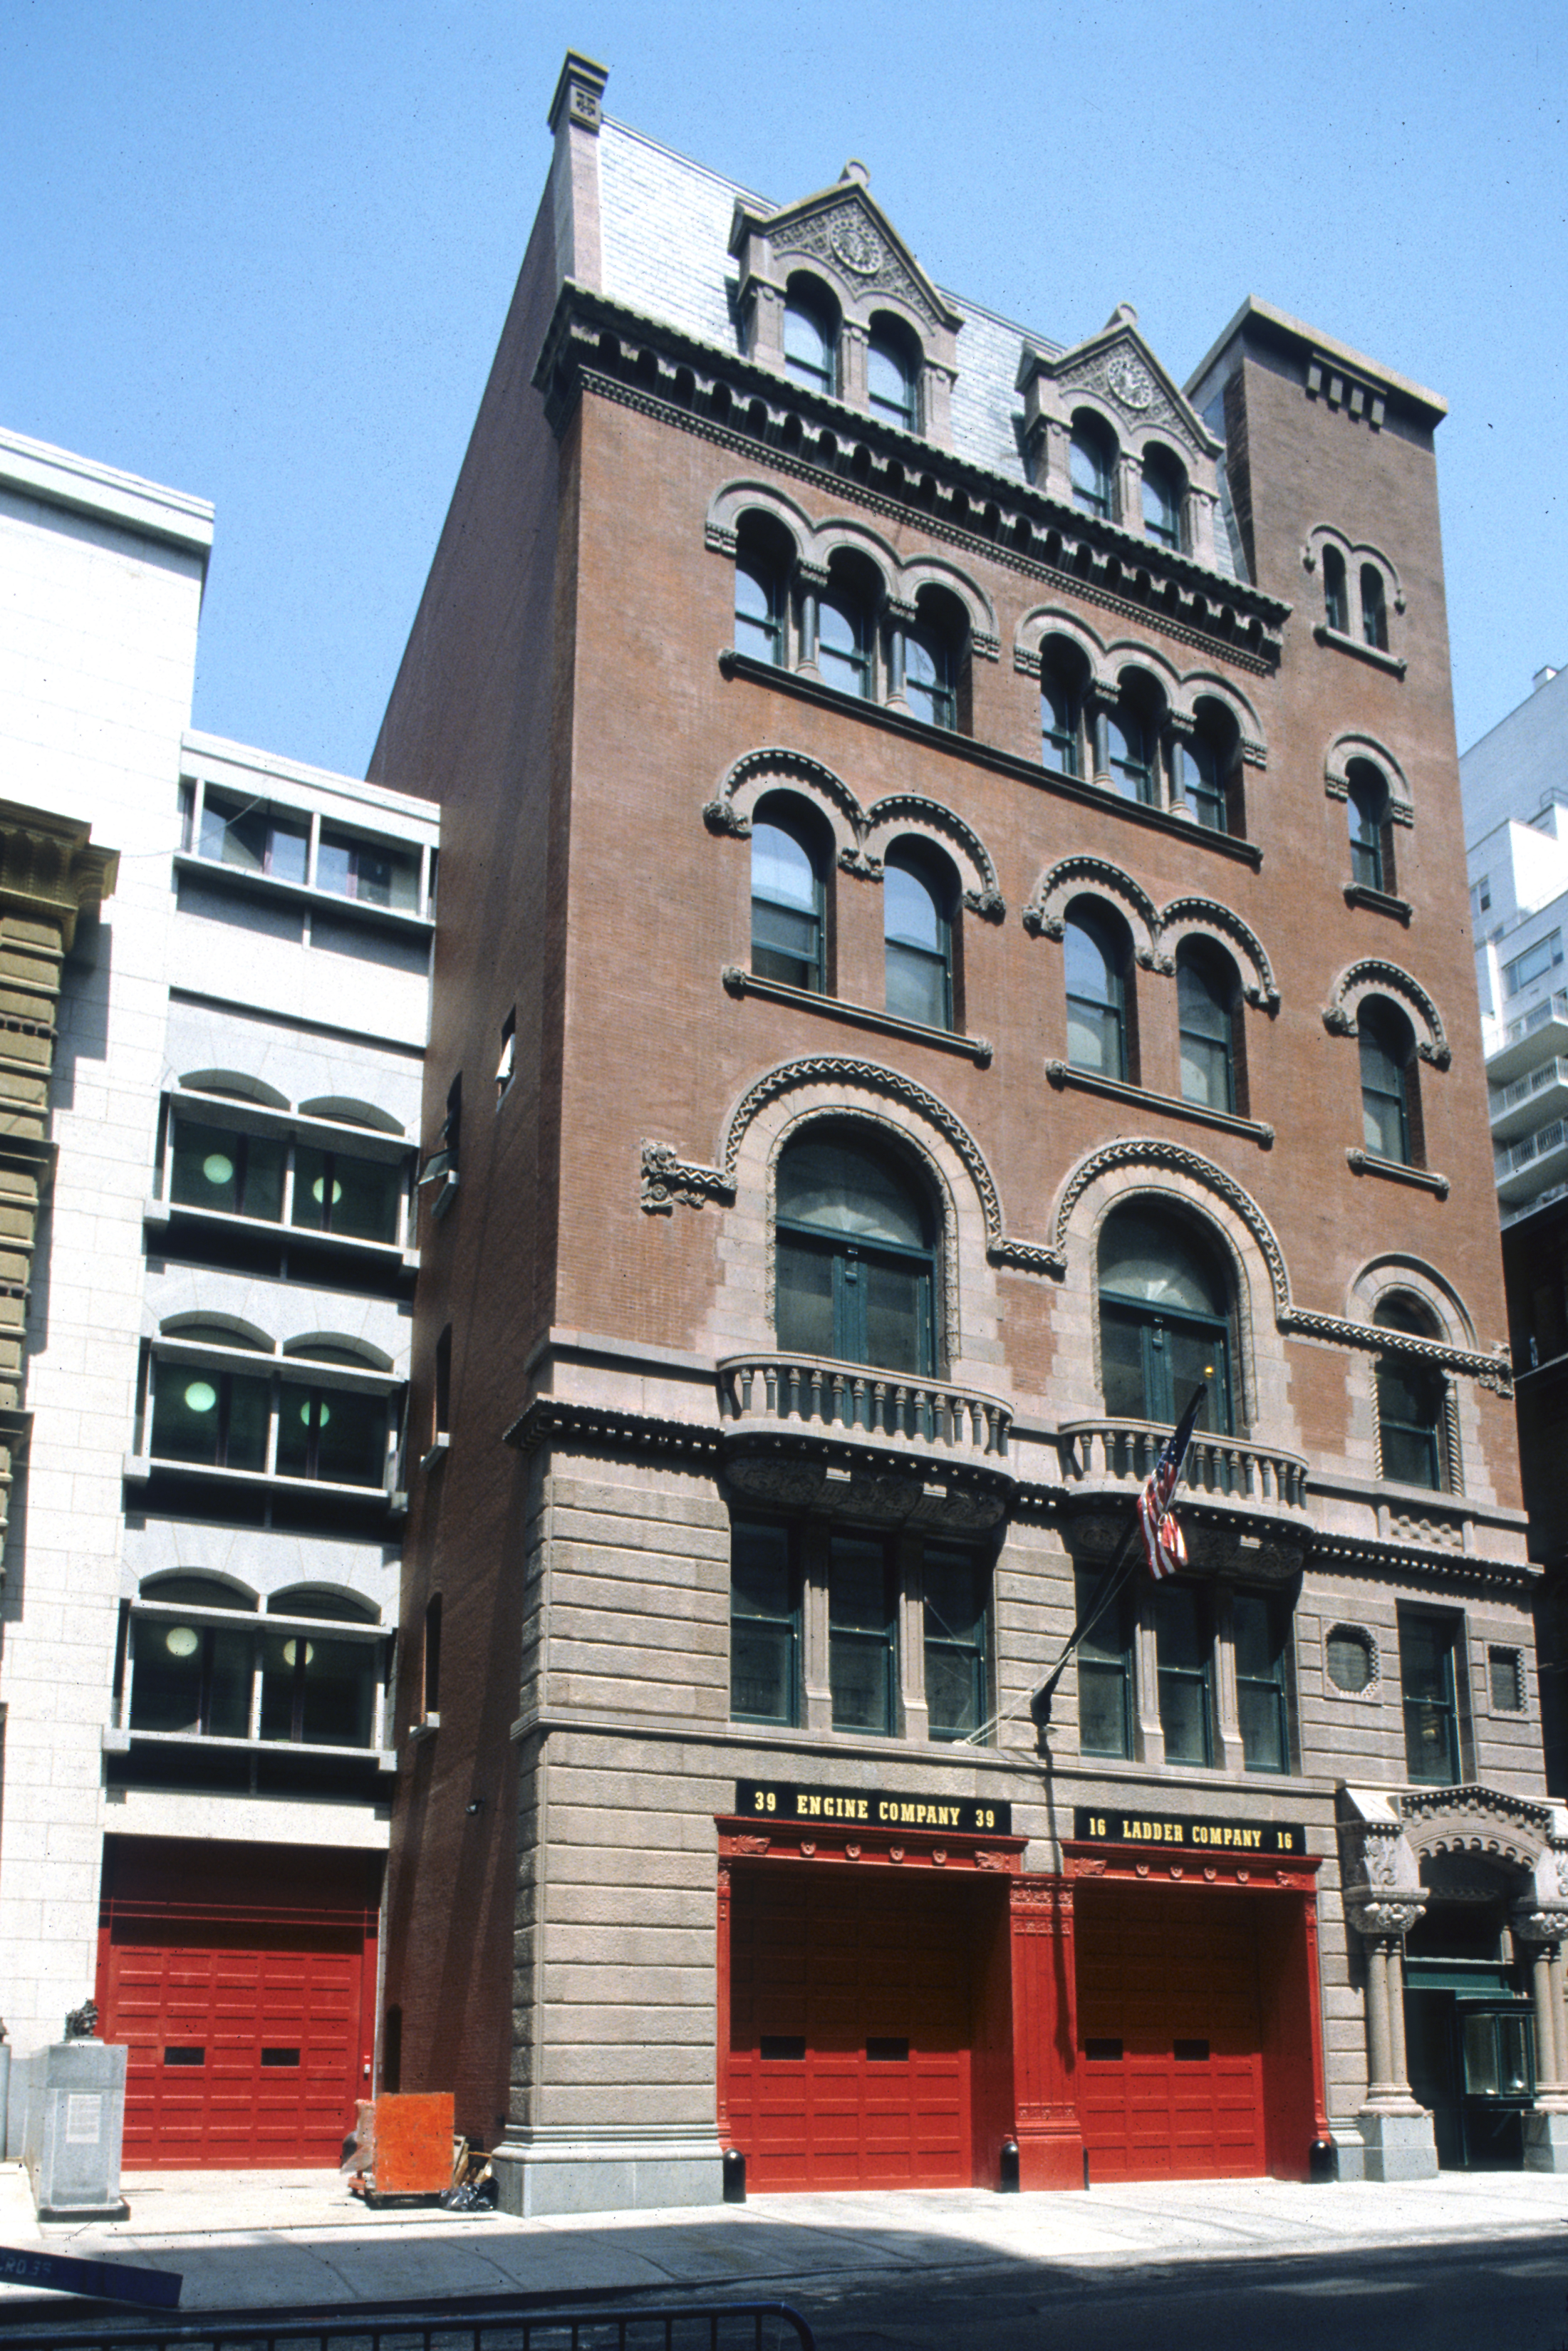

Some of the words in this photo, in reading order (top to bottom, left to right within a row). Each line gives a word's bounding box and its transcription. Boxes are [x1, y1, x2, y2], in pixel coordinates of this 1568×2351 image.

[754, 1791, 777, 1812] 39
[796, 1795, 868, 1820] ENGINE
[878, 1801, 961, 1826] COMPANY
[975, 1809, 995, 1828] 39
[1089, 1817, 1106, 1837] 16
[1122, 1820, 1184, 1843] LADDER
[1192, 1825, 1262, 1847] COMPANY
[1277, 1831, 1293, 1849] 16
